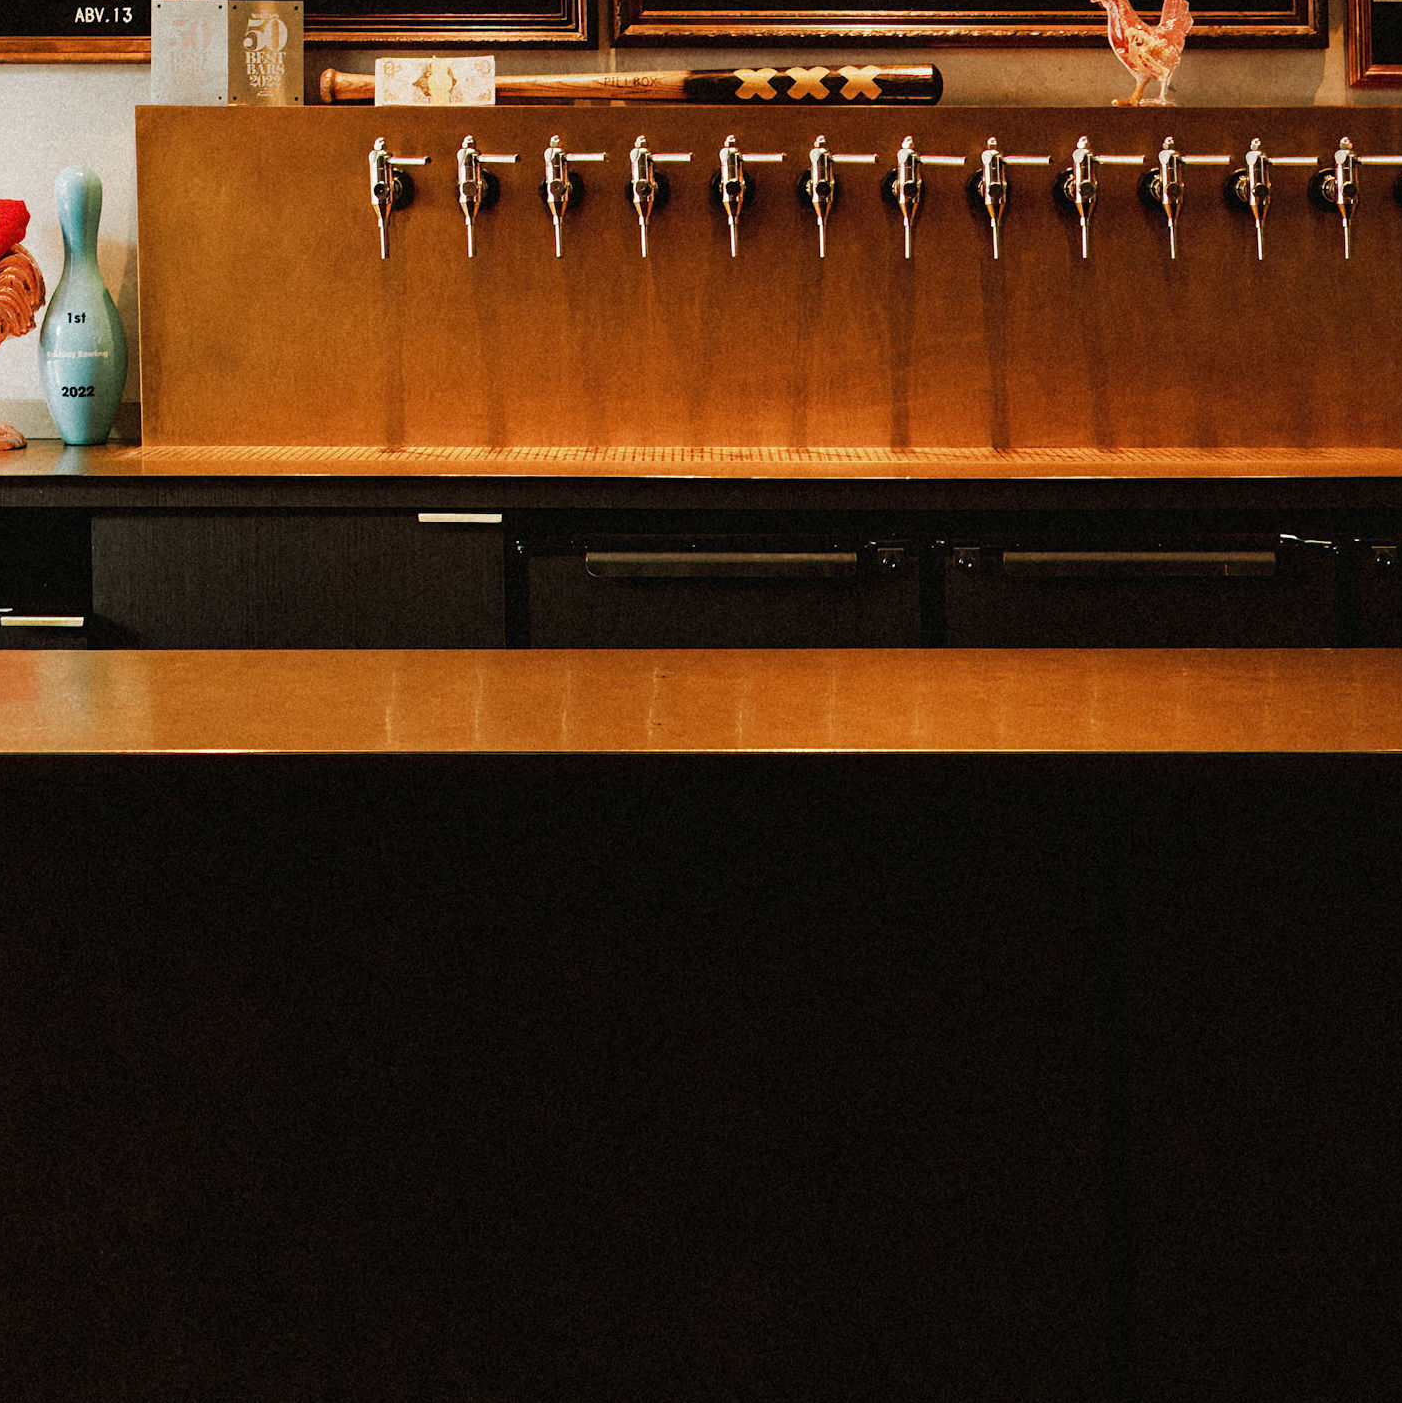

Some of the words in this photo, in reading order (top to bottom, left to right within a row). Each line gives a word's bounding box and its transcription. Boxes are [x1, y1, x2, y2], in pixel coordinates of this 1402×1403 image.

[243, 19, 288, 52] 50
[246, 52, 286, 64] BEST
[247, 64, 285, 75] BARS
[67, 312, 86, 324] 1st
[62, 386, 95, 397] 2022
